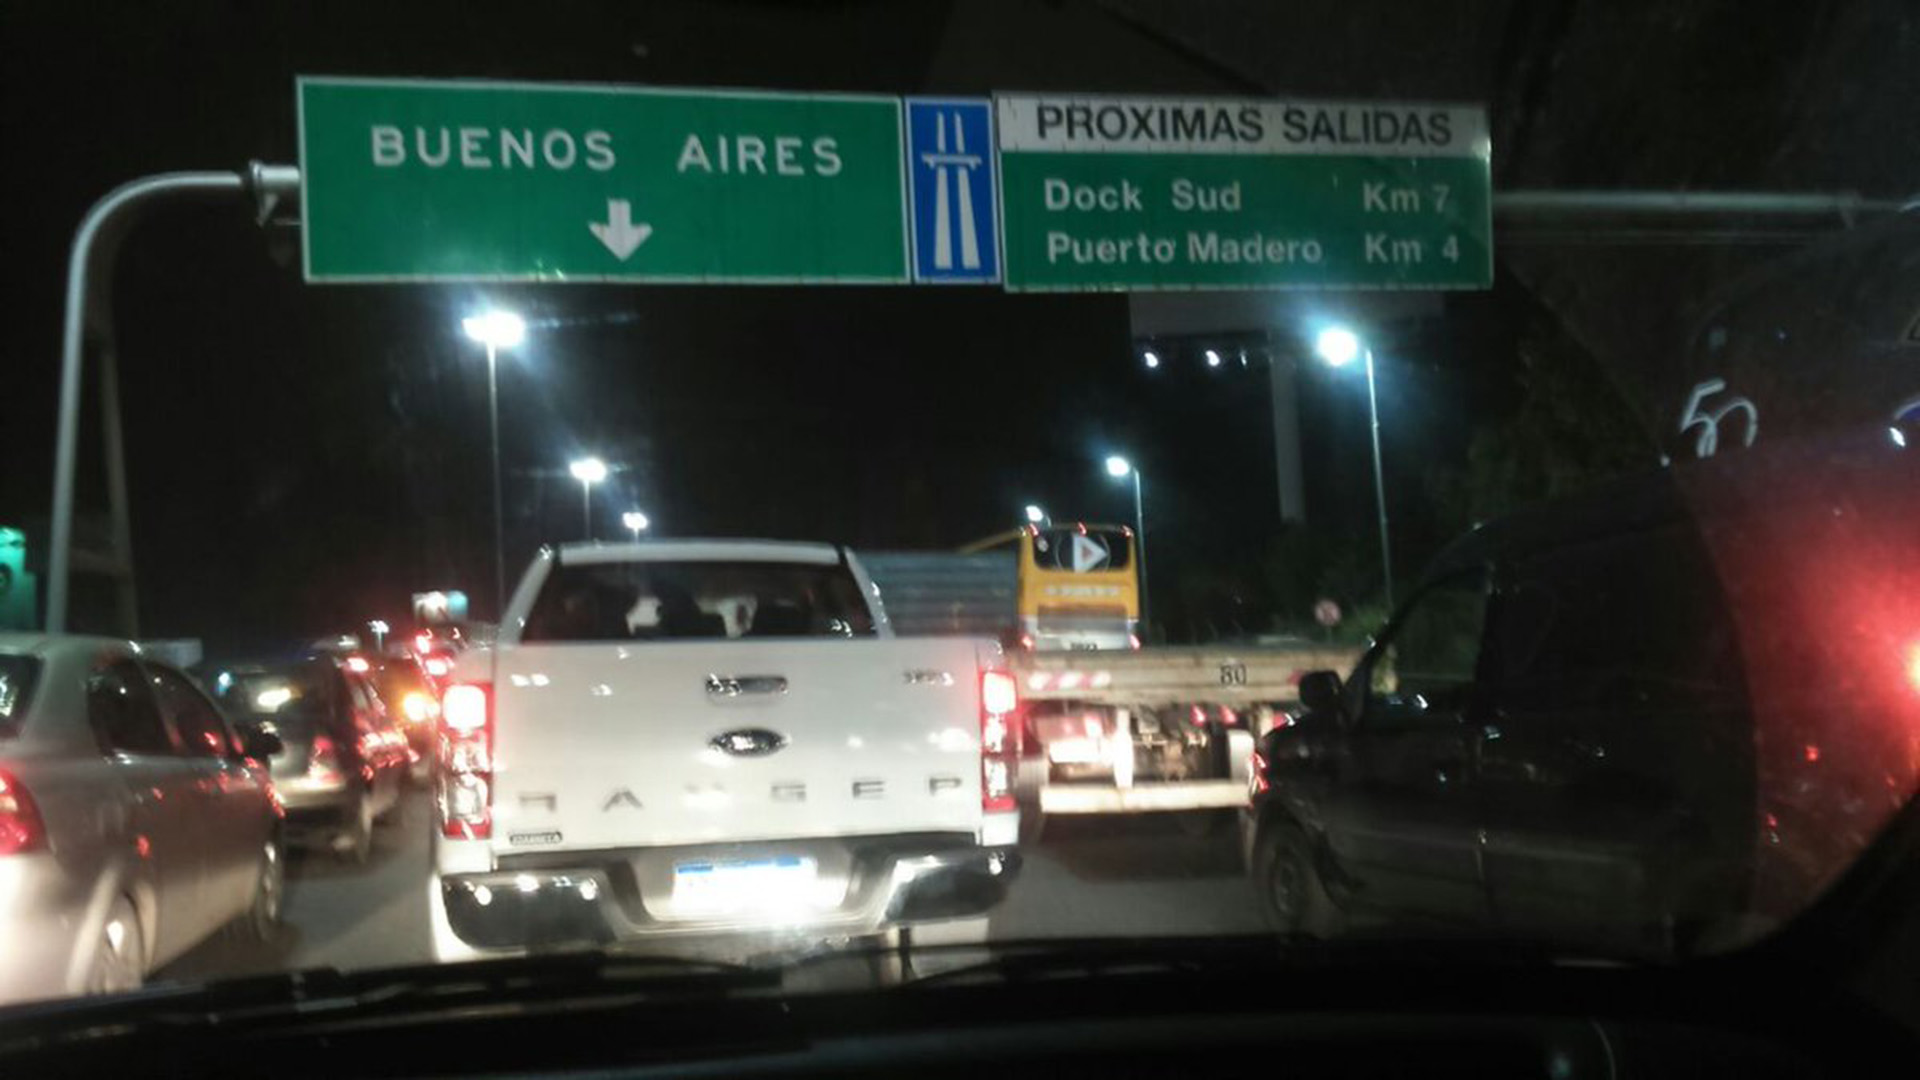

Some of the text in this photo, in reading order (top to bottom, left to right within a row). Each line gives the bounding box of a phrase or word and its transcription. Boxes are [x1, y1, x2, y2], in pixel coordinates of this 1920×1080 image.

[1036, 105, 1452, 146] PROXIMAS SALIDAS
[370, 125, 843, 176] BUENOS AIRES
[1043, 178, 1242, 212] Dock Sud
[1362, 181, 1451, 213] Km 7
[1047, 231, 1323, 265] Puerto Madero
[1365, 234, 1460, 264] Km 4
